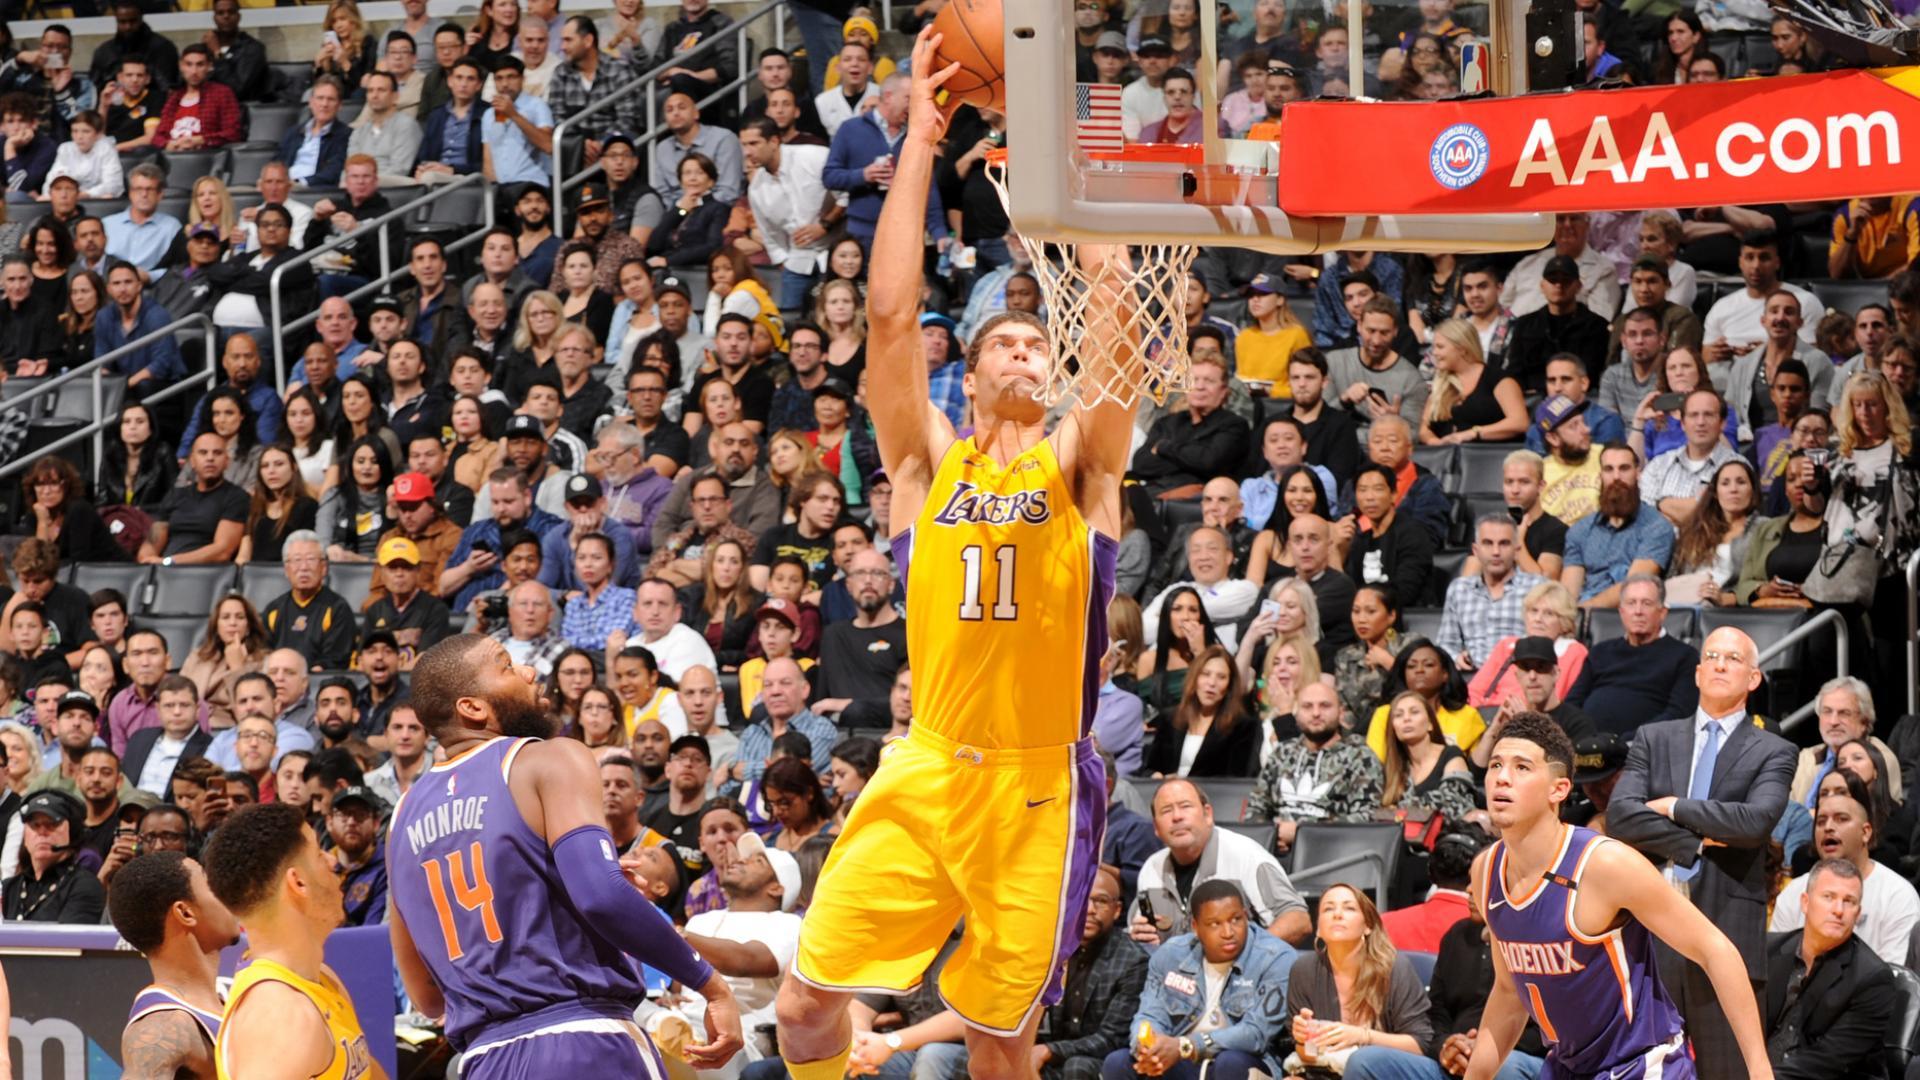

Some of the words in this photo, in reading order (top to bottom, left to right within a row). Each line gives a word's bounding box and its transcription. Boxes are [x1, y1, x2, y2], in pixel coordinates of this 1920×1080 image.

[1446, 146, 1473, 163] AAA
[1472, 130, 1487, 149] CLUB
[1509, 110, 1901, 188] AAA.com
[1431, 154, 1457, 187] SOUTHERN
[1457, 152, 1488, 187] CALIFORNIA
[933, 481, 1050, 526] LAKERS
[959, 543, 1018, 621] 11
[406, 796, 488, 855] MONROE
[420, 840, 504, 961] 14
[1497, 940, 1586, 975] HOENIX
[1525, 983, 1560, 1042] 1
